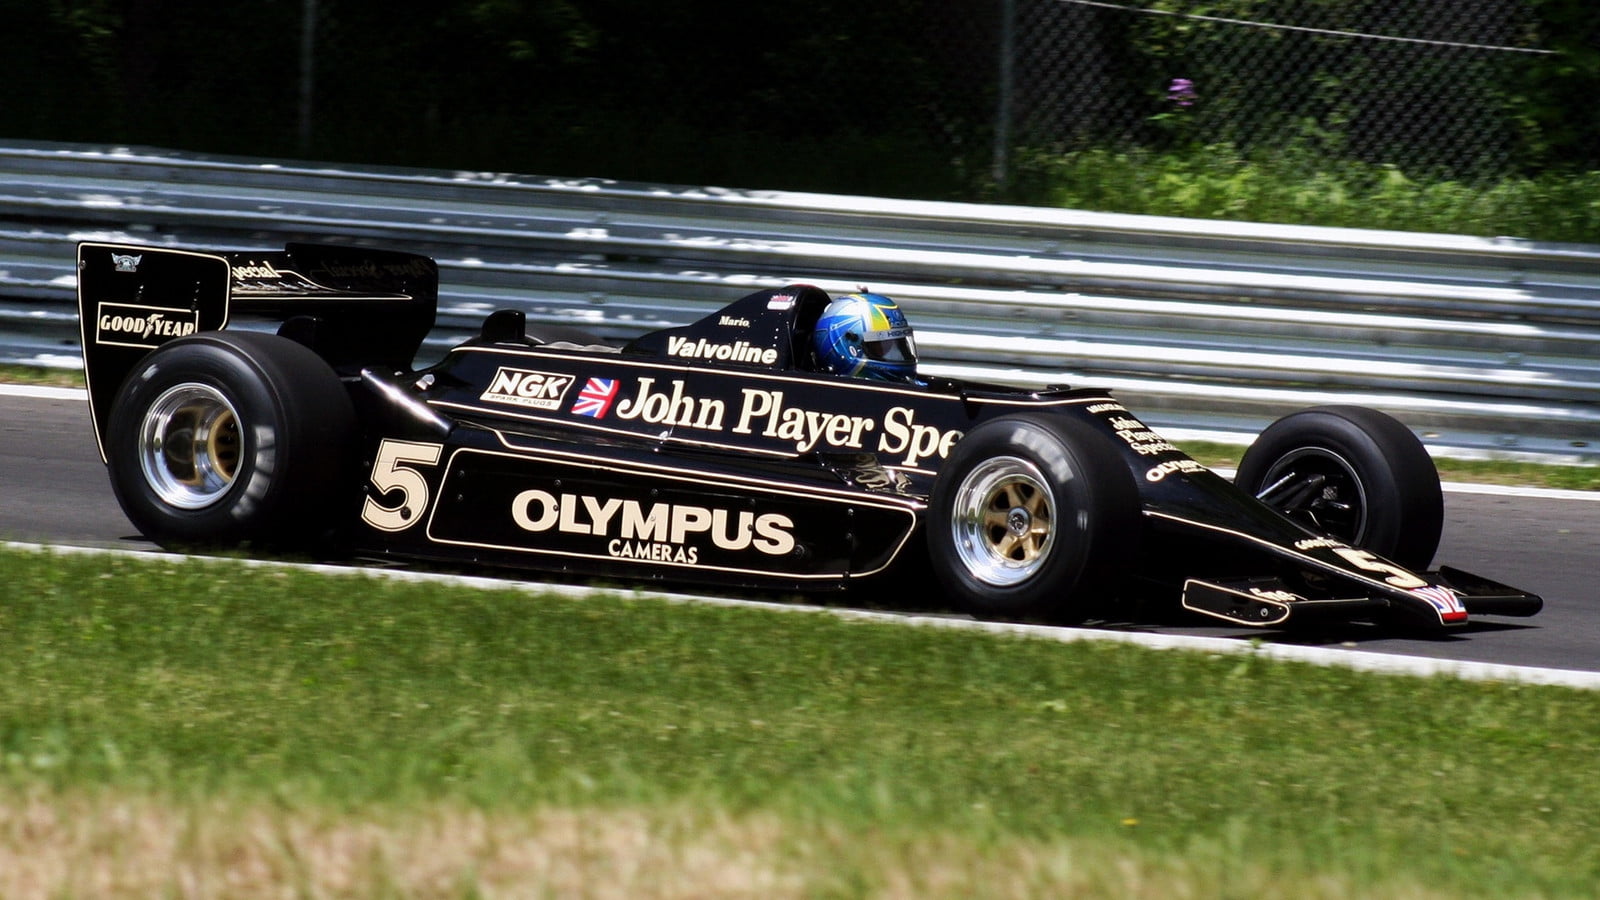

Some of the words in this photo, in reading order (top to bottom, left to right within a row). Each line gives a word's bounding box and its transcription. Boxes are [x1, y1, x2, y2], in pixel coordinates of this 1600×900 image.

[231, 260, 283, 281] pecial
[718, 315, 750, 327] Mario
[667, 336, 777, 365] Valvoline
[489, 370, 562, 402] NGK
[522, 399, 554, 408] PLUGS
[615, 377, 725, 431] John
[731, 388, 875, 453] Player
[877, 406, 965, 467] Spe
[360, 438, 444, 532] 5
[511, 488, 796, 557] OLYMPUS
[607, 539, 698, 565] CAMERAS
[1331, 547, 1429, 590] 5
